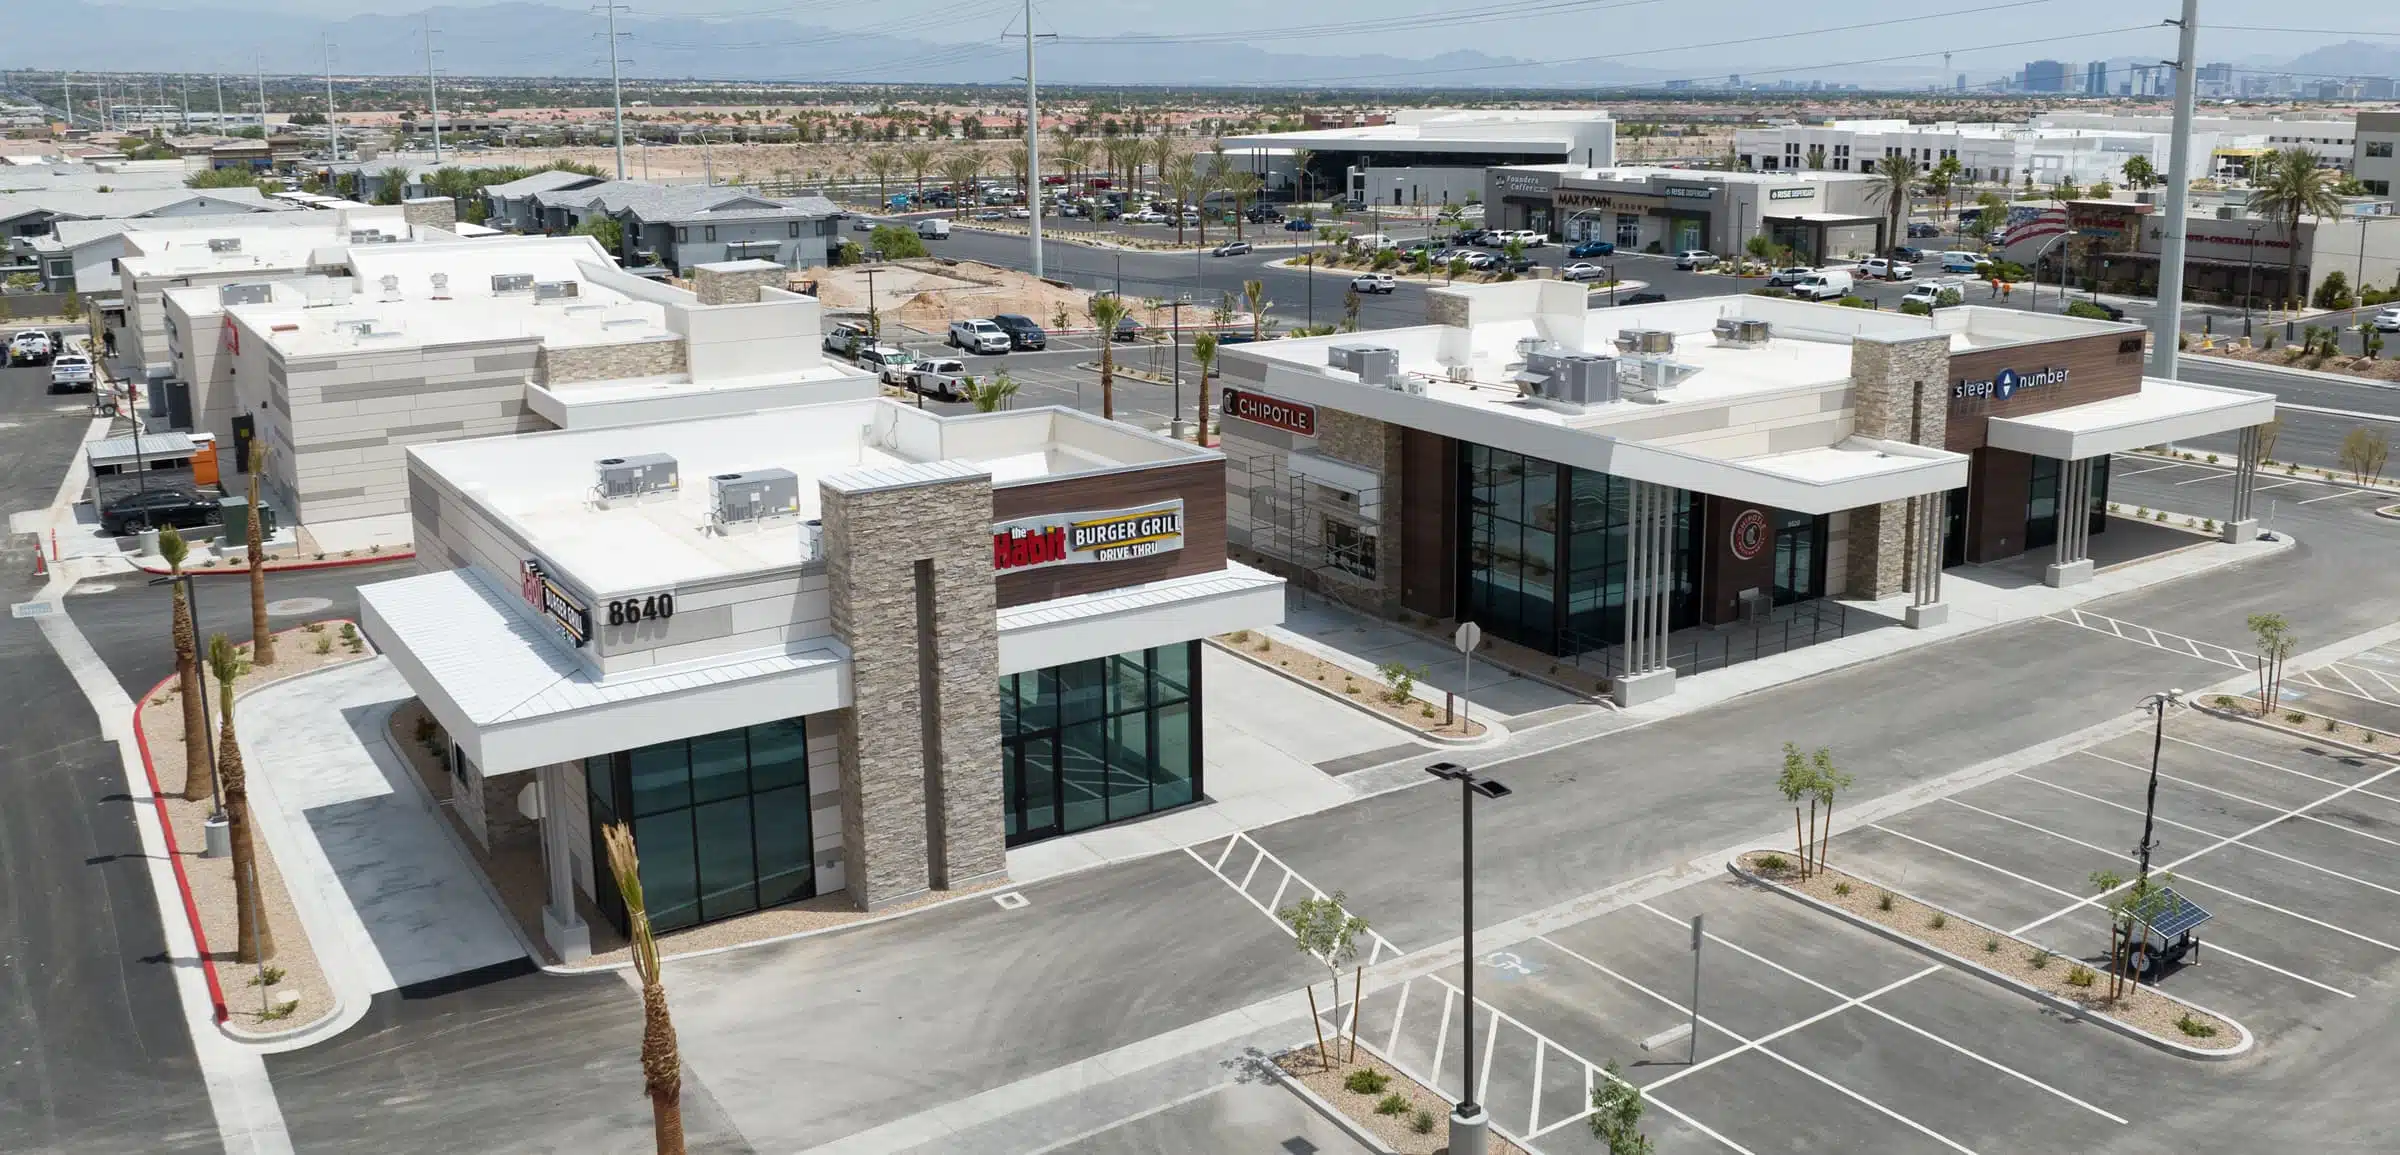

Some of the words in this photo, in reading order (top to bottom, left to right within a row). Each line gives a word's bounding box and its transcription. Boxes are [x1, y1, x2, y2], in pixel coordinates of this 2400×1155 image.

[1510, 183, 1534, 192] Coffee
[1671, 188, 1685, 197] RISE
[1777, 190, 1791, 199] RISE
[1558, 193, 1581, 206] MAX
[1955, 380, 1994, 399] sleep
[2019, 368, 2070, 388] number
[1239, 398, 1307, 429] CHIPOTLE
[1011, 527, 1027, 540] the
[993, 525, 1067, 570] Habit
[1075, 520, 1137, 546] BURGER
[1140, 515, 1182, 536] GRILL
[1099, 545, 1131, 562] DRIVE
[1132, 541, 1158, 557] THRU
[608, 593, 674, 626] 8640
